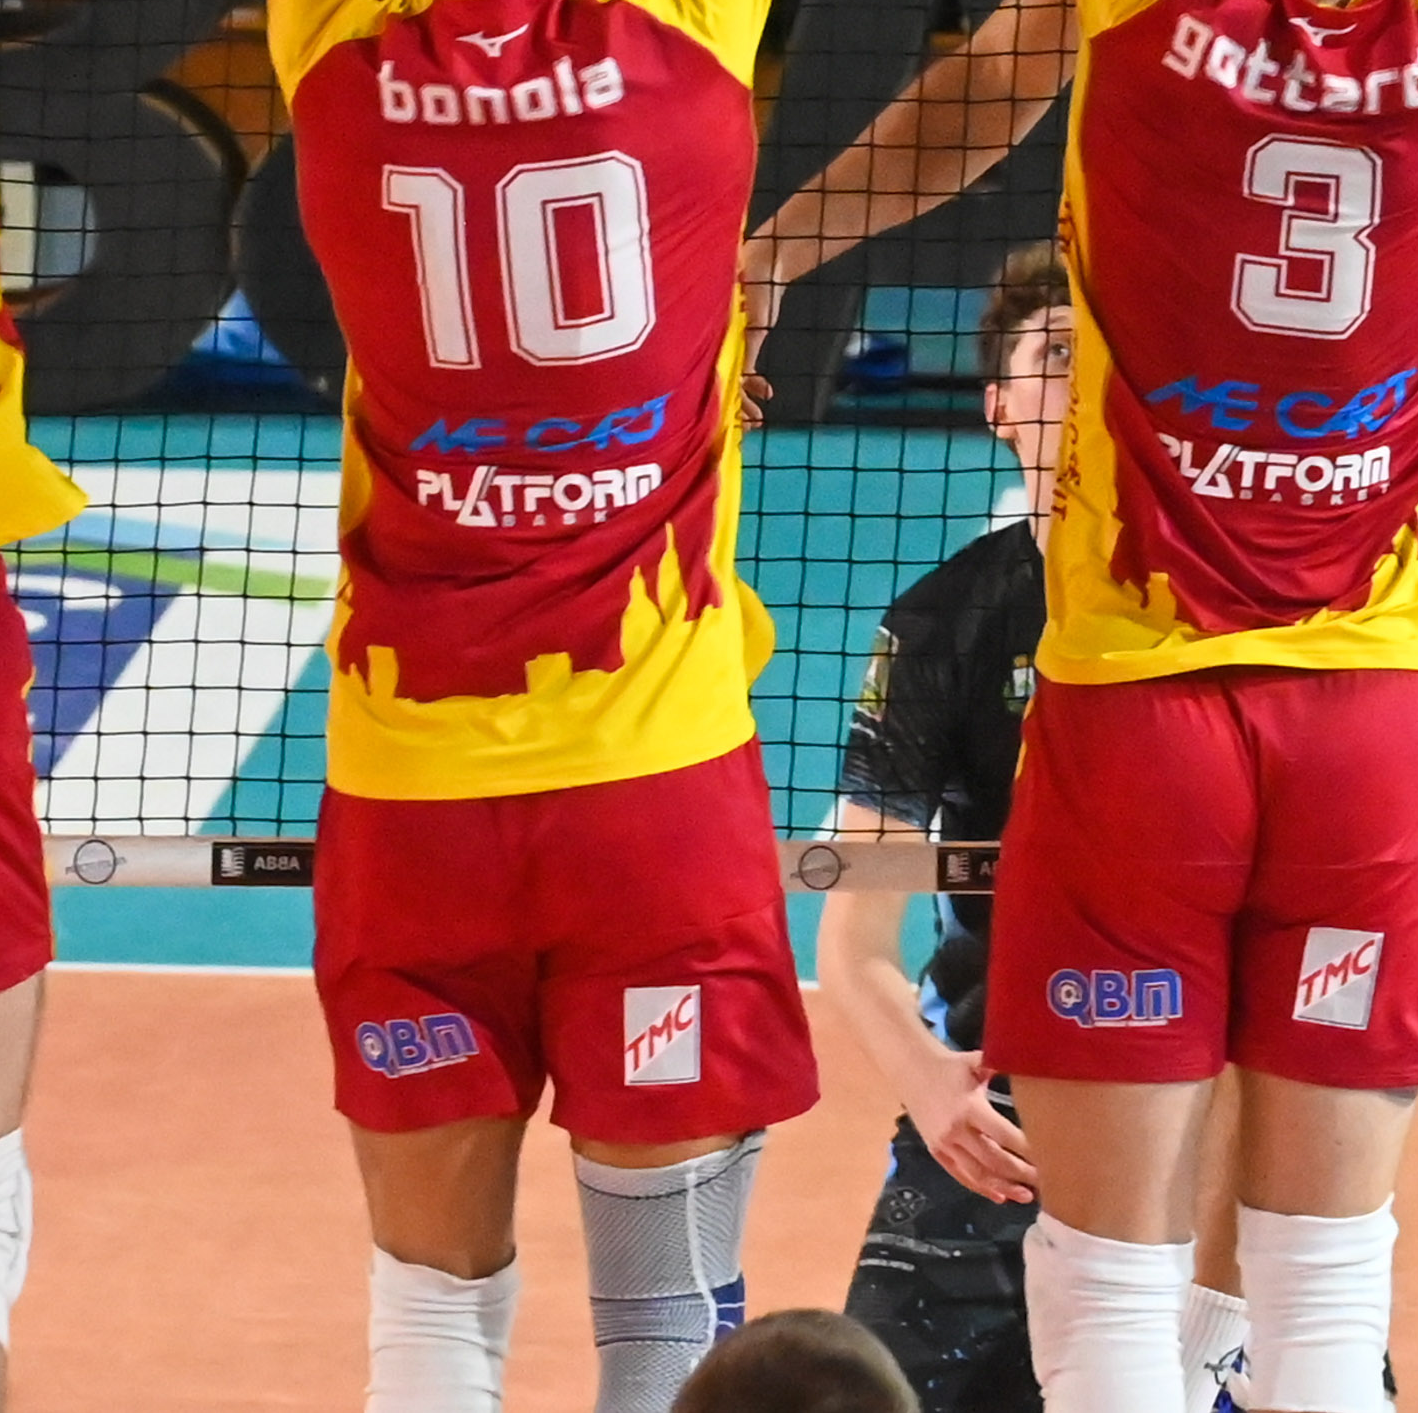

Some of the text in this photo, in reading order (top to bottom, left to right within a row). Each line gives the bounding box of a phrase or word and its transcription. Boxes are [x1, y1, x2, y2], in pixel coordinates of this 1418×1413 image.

[376, 54, 625, 127] bonola
[381, 148, 656, 370] 10
[1231, 133, 1383, 342] 3
[416, 462, 663, 528] PLATFORM
[1155, 431, 1392, 499] PLATFORM
[1046, 968, 1183, 1029] QBM
[1301, 939, 1376, 1007] TMC
[356, 1011, 480, 1079] QBM
[626, 992, 695, 1073] TMC
